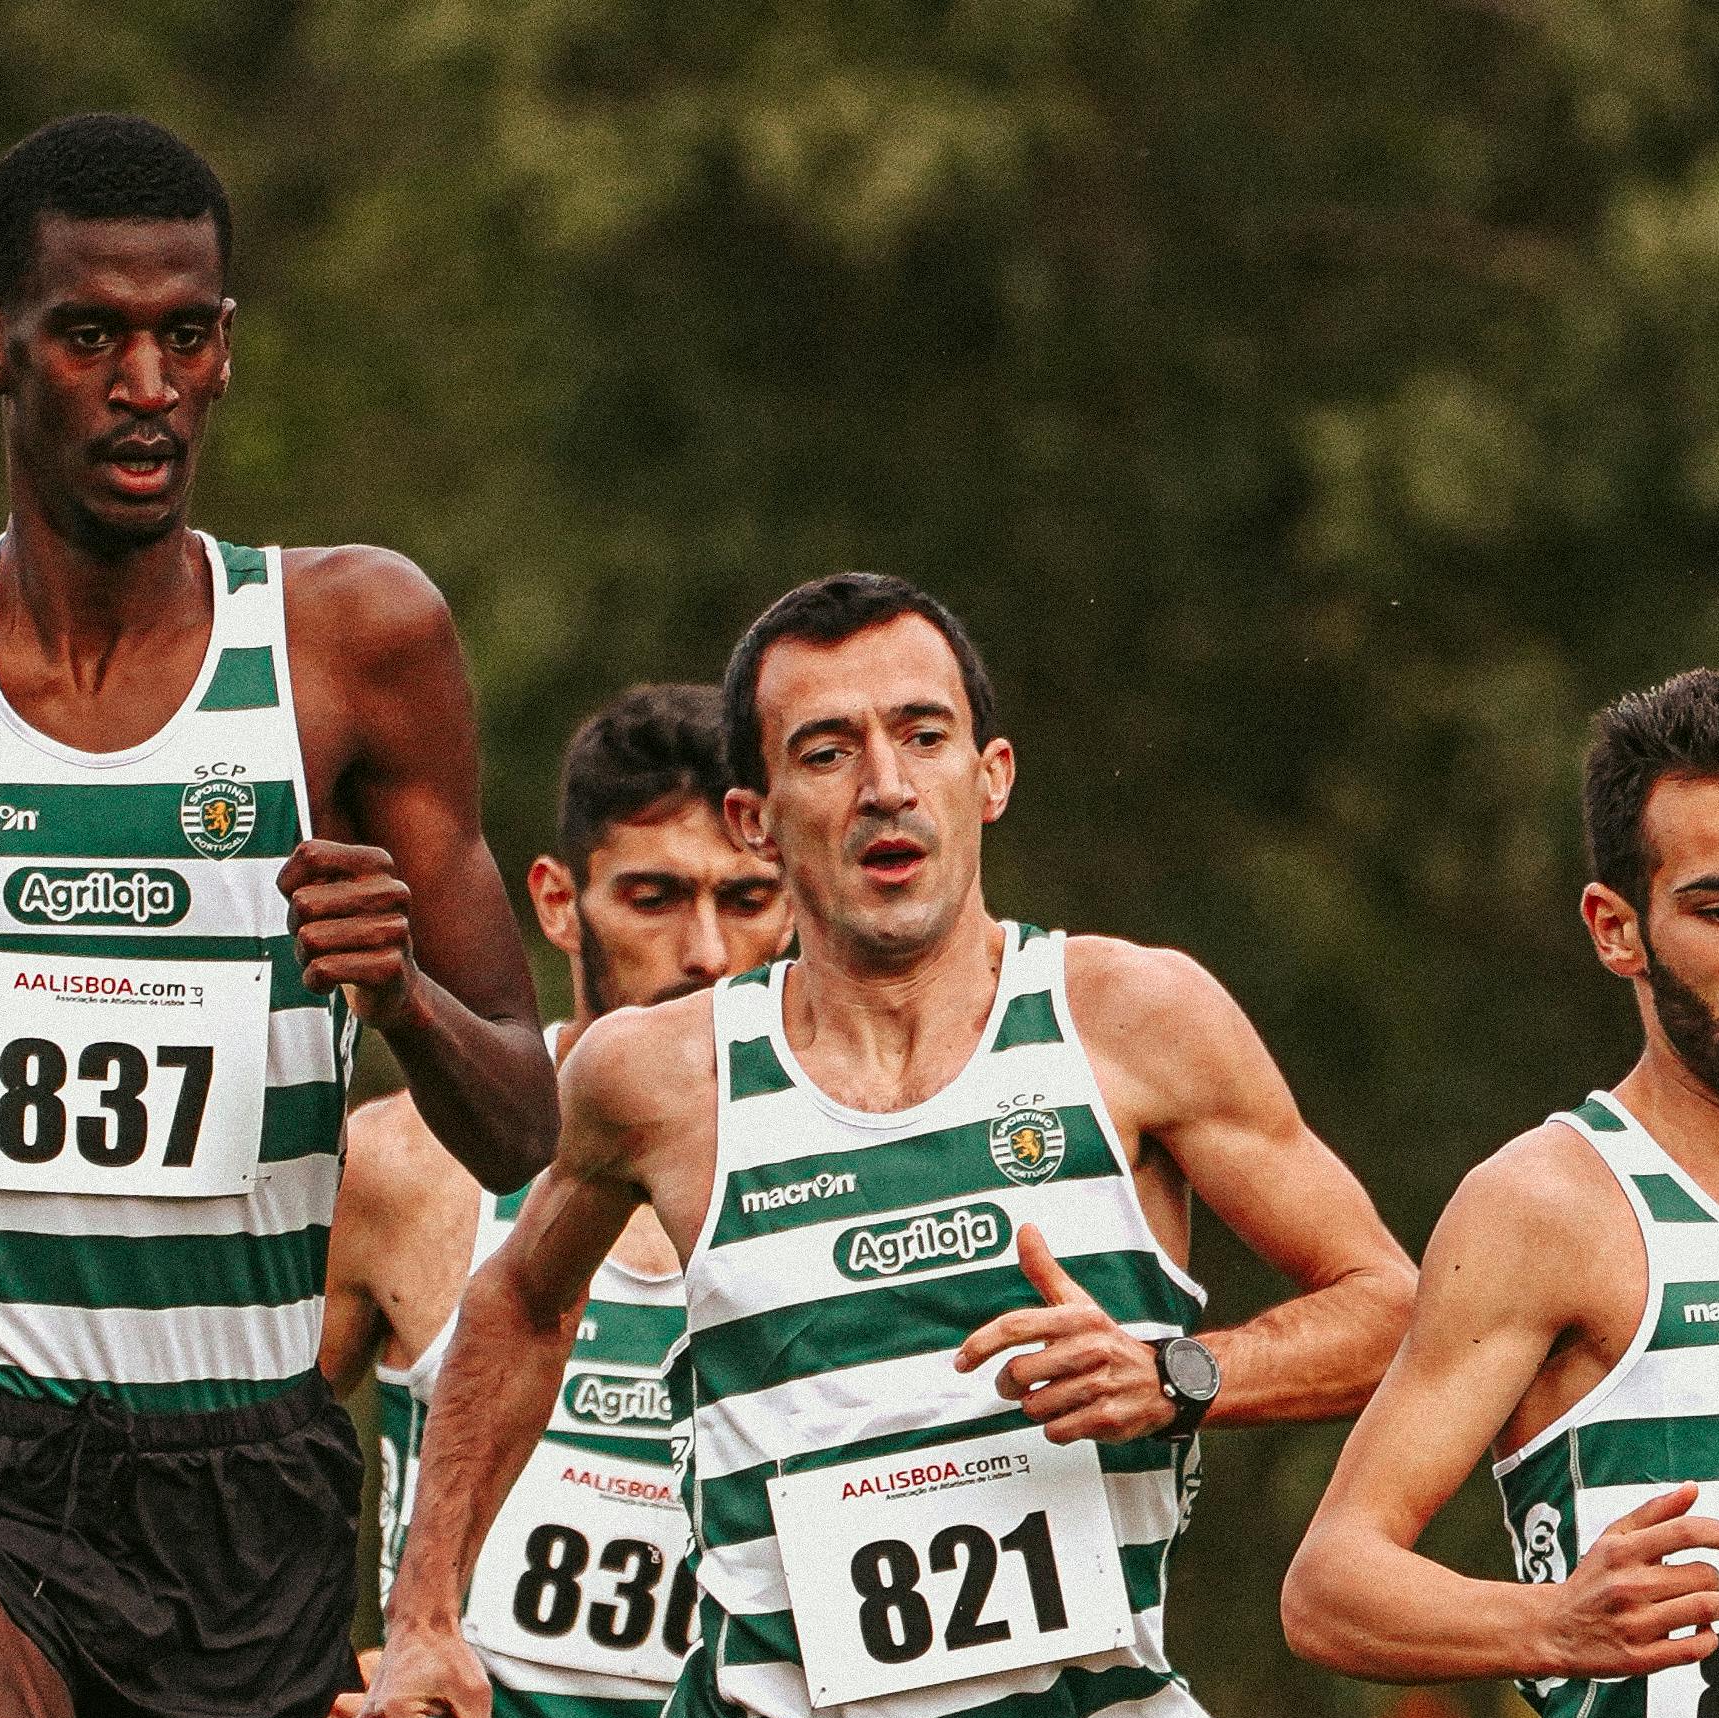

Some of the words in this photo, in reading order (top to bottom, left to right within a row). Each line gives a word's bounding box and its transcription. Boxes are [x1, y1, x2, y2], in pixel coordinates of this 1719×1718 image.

[194, 761, 246, 780] SCP
[188, 783, 249, 805] SPORTING
[21, 873, 174, 922] Agriloja
[13, 972, 186, 997] AALISBOA.com
[996, 1093, 1046, 1114] SCP
[741, 1172, 857, 1214] macron
[848, 1209, 997, 1275] Agriloja
[574, 1378, 672, 1424] Agrilo
[559, 1466, 675, 1502] AALISBOA
[841, 1454, 1012, 1501] AALISBOA.com
[850, 1509, 1069, 1664] 821
